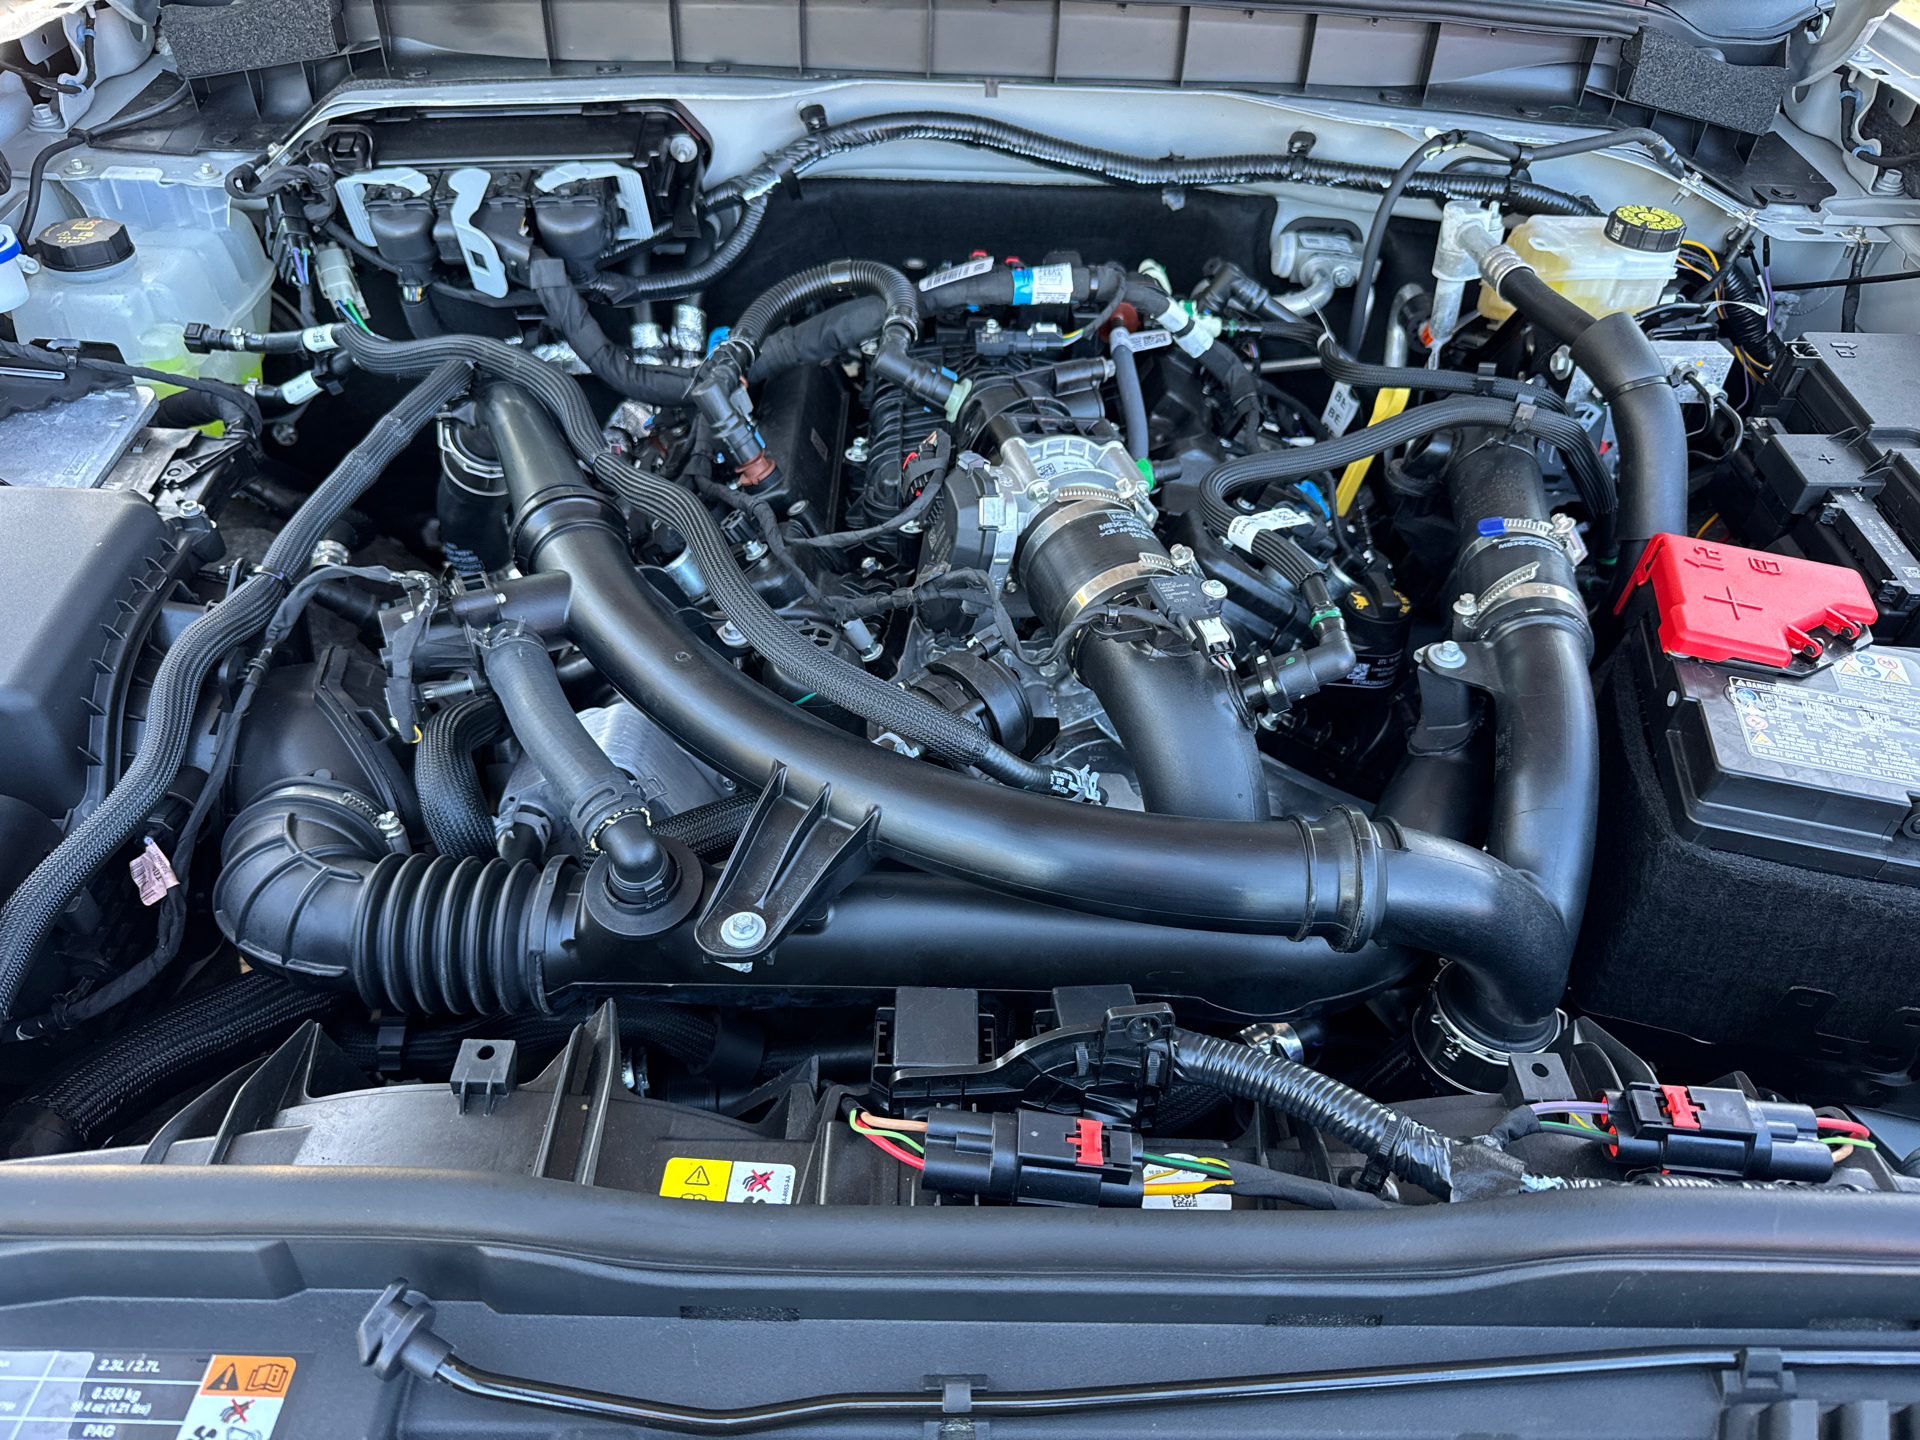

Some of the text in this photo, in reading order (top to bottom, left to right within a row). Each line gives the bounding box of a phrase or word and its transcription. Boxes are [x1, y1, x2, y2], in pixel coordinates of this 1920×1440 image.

[1745, 681, 1809, 698] DANGER/POISON
[97, 1359, 124, 1372] 2.3L
[132, 1359, 161, 1373] 2.7L
[82, 1423, 116, 1438] PAG
